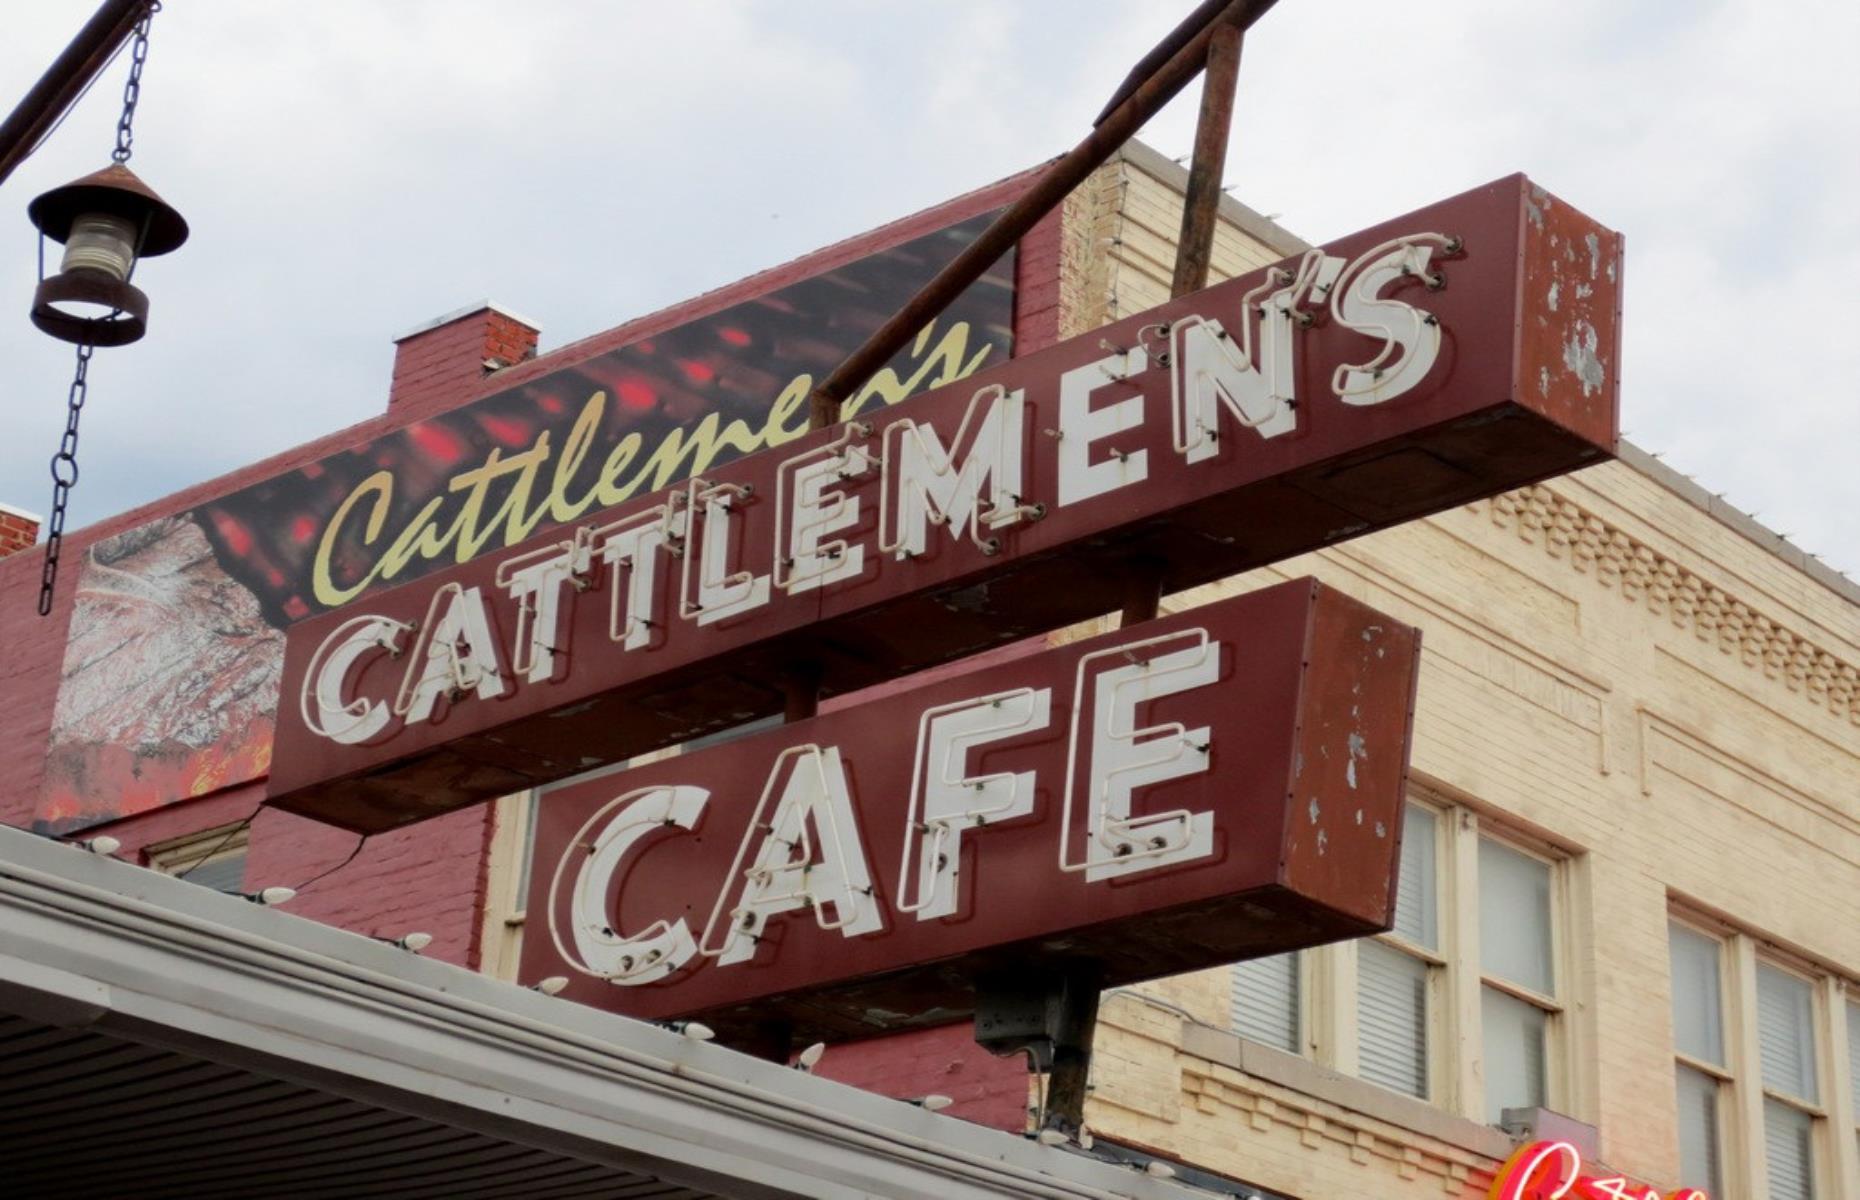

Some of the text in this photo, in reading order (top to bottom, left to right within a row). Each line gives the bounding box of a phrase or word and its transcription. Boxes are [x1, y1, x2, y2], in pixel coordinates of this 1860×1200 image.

[302, 232, 1461, 745] CATTLEMEN'S
[312, 320, 993, 606] Cattlemen's
[549, 627, 1221, 986] CAFE
